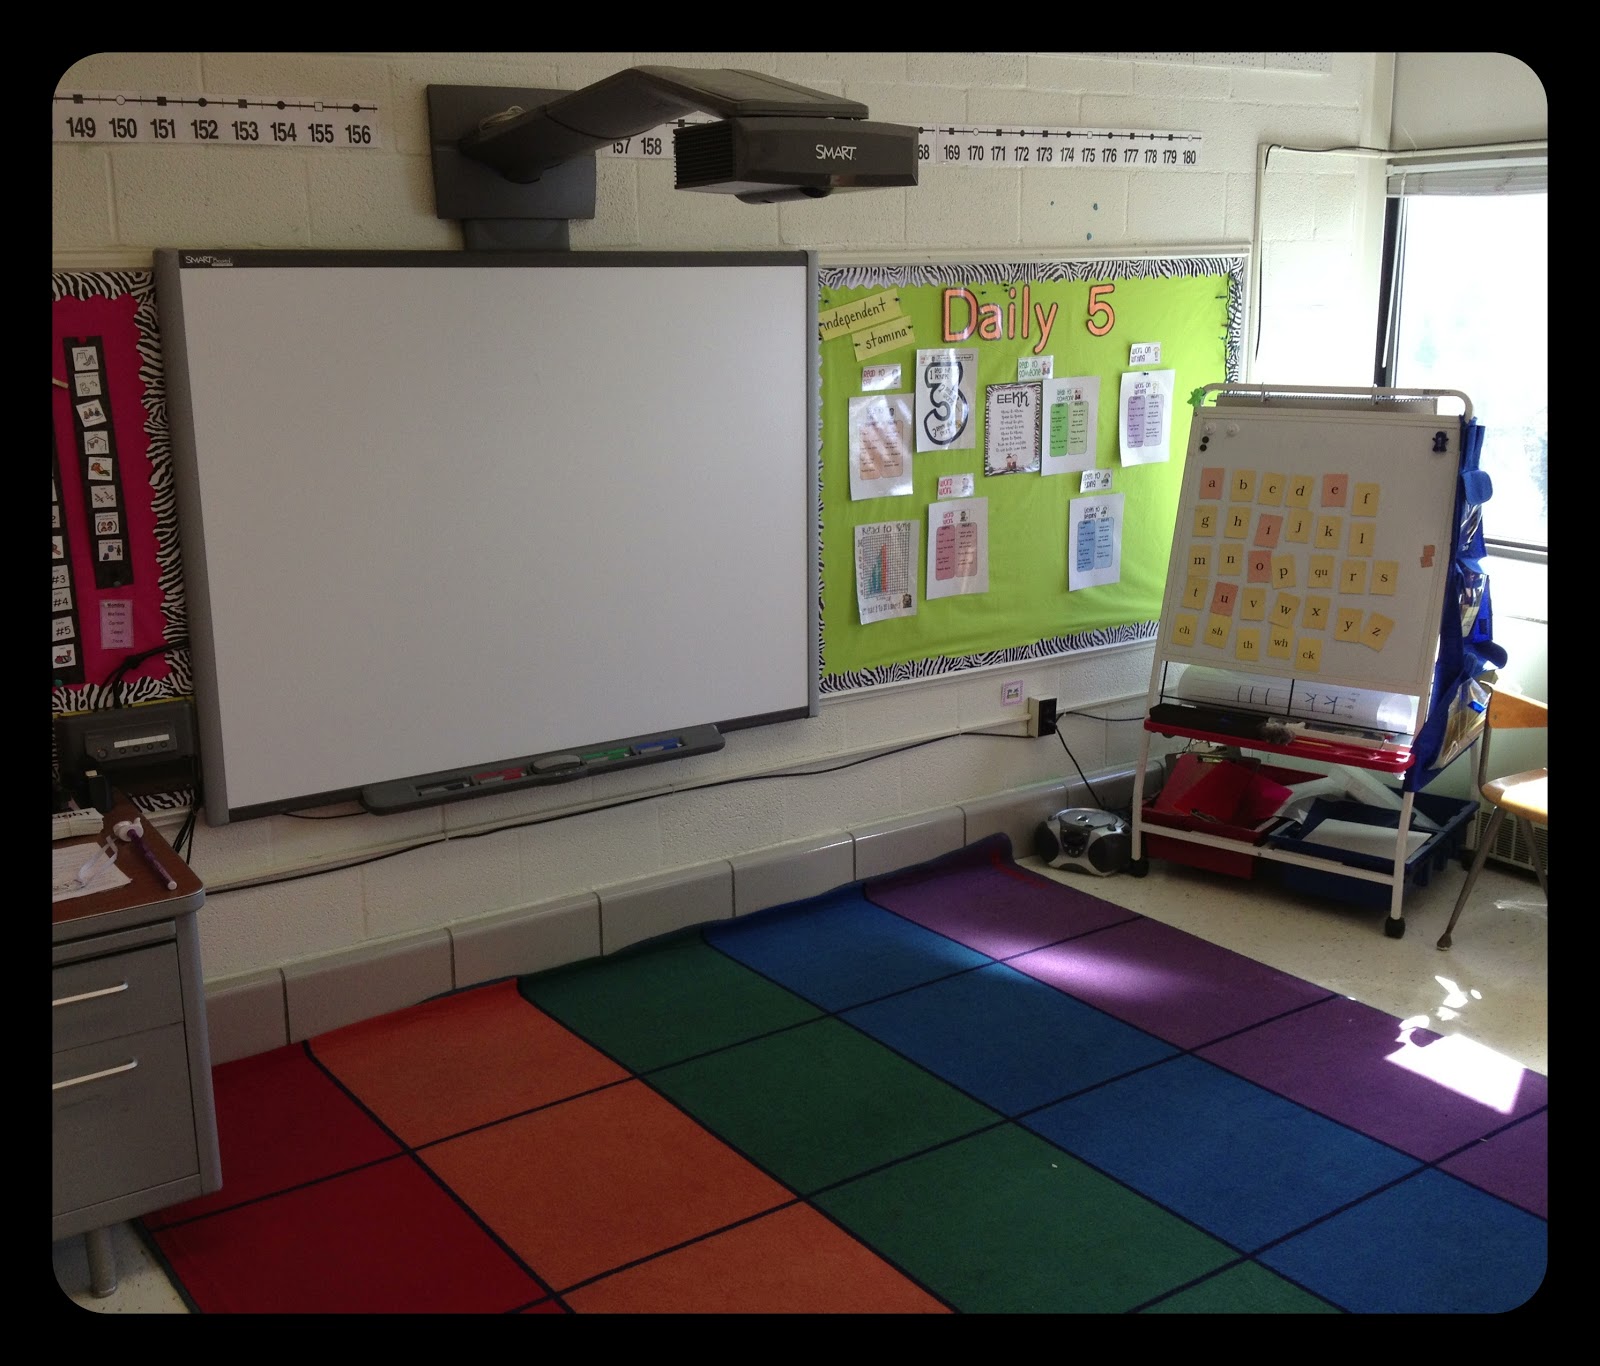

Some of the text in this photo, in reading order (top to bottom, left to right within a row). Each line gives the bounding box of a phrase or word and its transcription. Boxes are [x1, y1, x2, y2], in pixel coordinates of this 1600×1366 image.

[66, 117, 371, 144] 149 150 151 152 153 154 155 156
[641, 137, 662, 156] 158
[815, 144, 856, 160] SMART
[918, 144, 1196, 165] 68 169 170 171 172 173 174 175 176 177 178 179 180
[185, 255, 213, 264] SMART
[822, 297, 886, 330] independent
[943, 283, 1115, 354] Daily 5
[865, 329, 908, 350] stamina
[996, 391, 1029, 408] EEKK
[1239, 480, 1248, 489] b
[1295, 486, 1305, 496] d
[1363, 493, 1371, 503] f
[1201, 517, 1210, 527] g
[1233, 516, 1242, 526] h
[1324, 526, 1333, 536] k
[1279, 568, 1288, 579] p
[1314, 570, 1328, 578] qu
[1349, 573, 1357, 581] r
[1380, 574, 1389, 582] s
[53, 597, 69, 607] #4
[1220, 594, 1229, 603] u
[1280, 605, 1292, 614] w
[1311, 608, 1321, 616] x
[1343, 620, 1354, 632] y
[1371, 627, 1381, 636] z
[56, 625, 71, 637] #5
[1179, 625, 1315, 659] ch sh th wh ck
